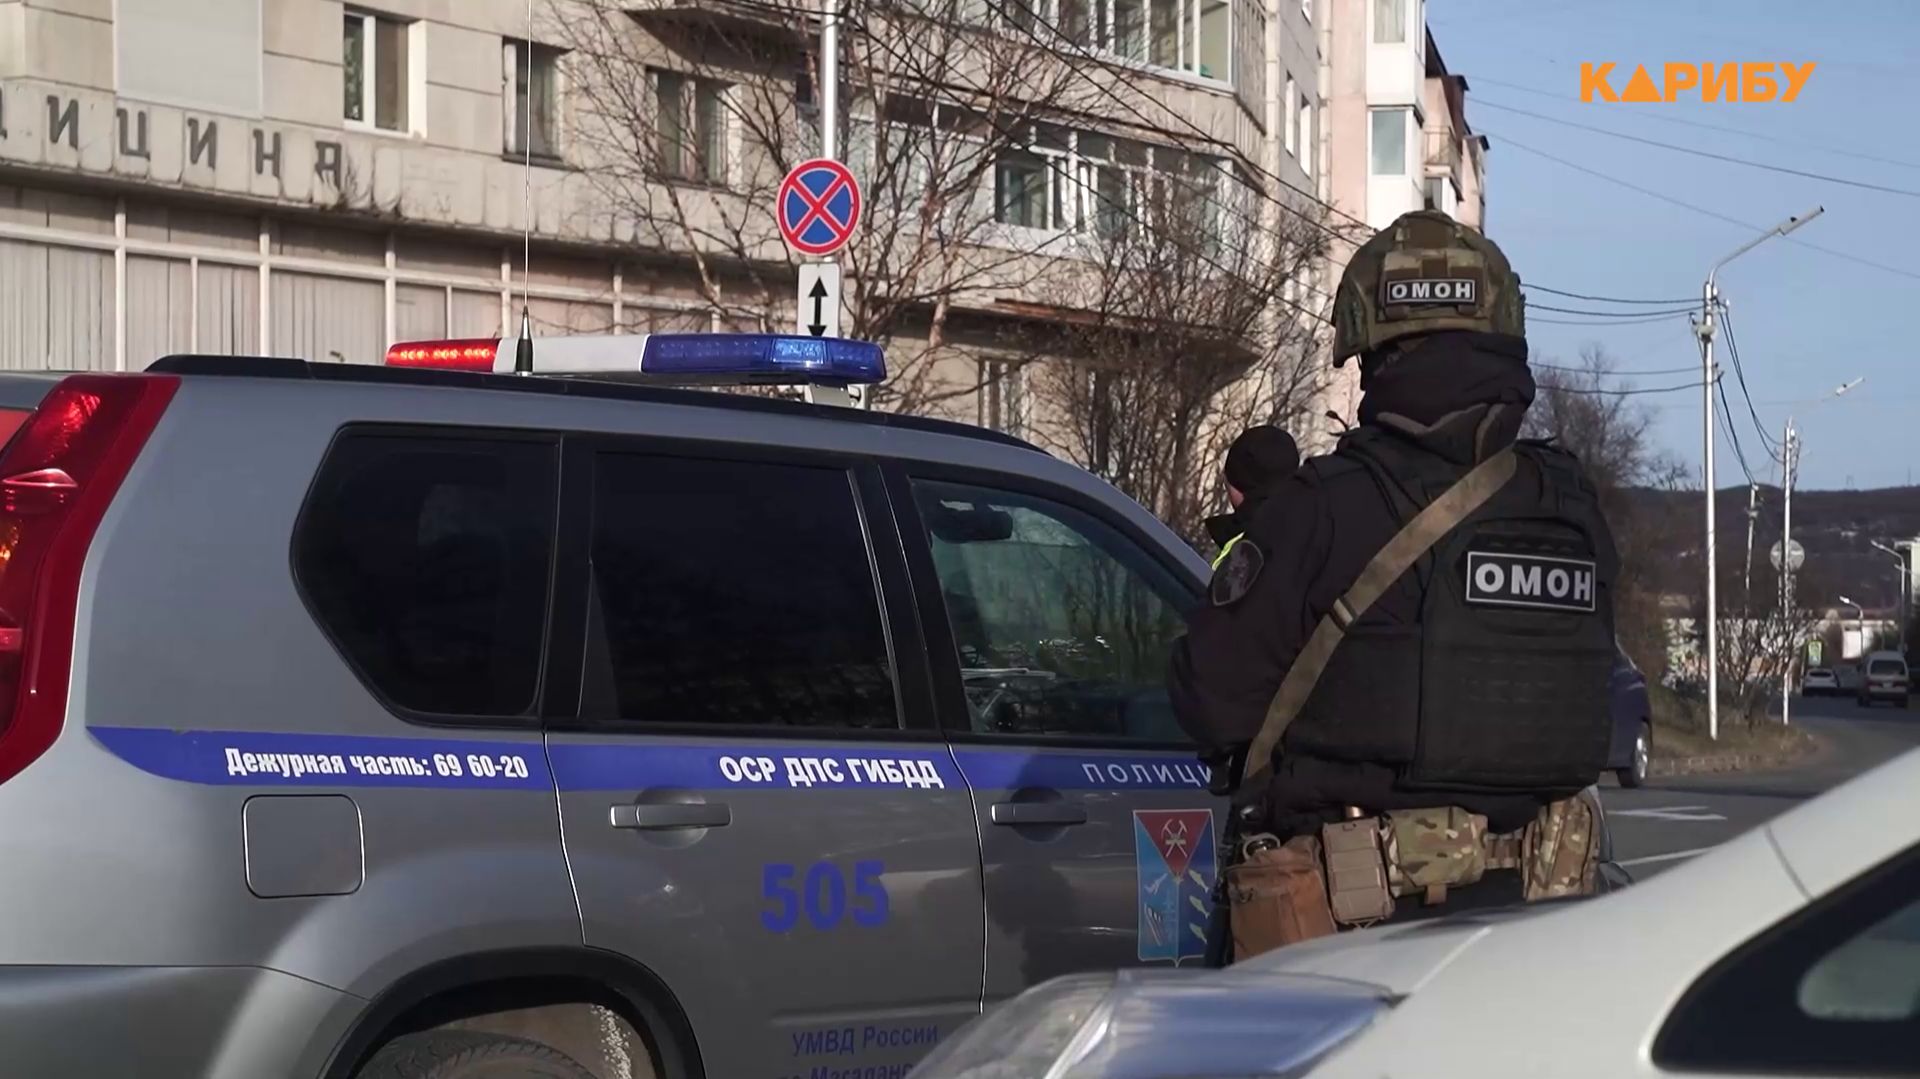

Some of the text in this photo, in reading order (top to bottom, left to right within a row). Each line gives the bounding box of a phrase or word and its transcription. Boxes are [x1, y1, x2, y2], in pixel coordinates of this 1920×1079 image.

[0, 82, 343, 191] ИЦИНА
[1391, 282, 1471, 299] ОМОН
[1475, 563, 1592, 601] ОМОН
[225, 748, 529, 778] Дежурная часть: 69 60-20
[719, 756, 945, 789] ОСР ДПС ГИБДД
[760, 860, 889, 934] 505
[792, 1025, 939, 1057] УМВД России
